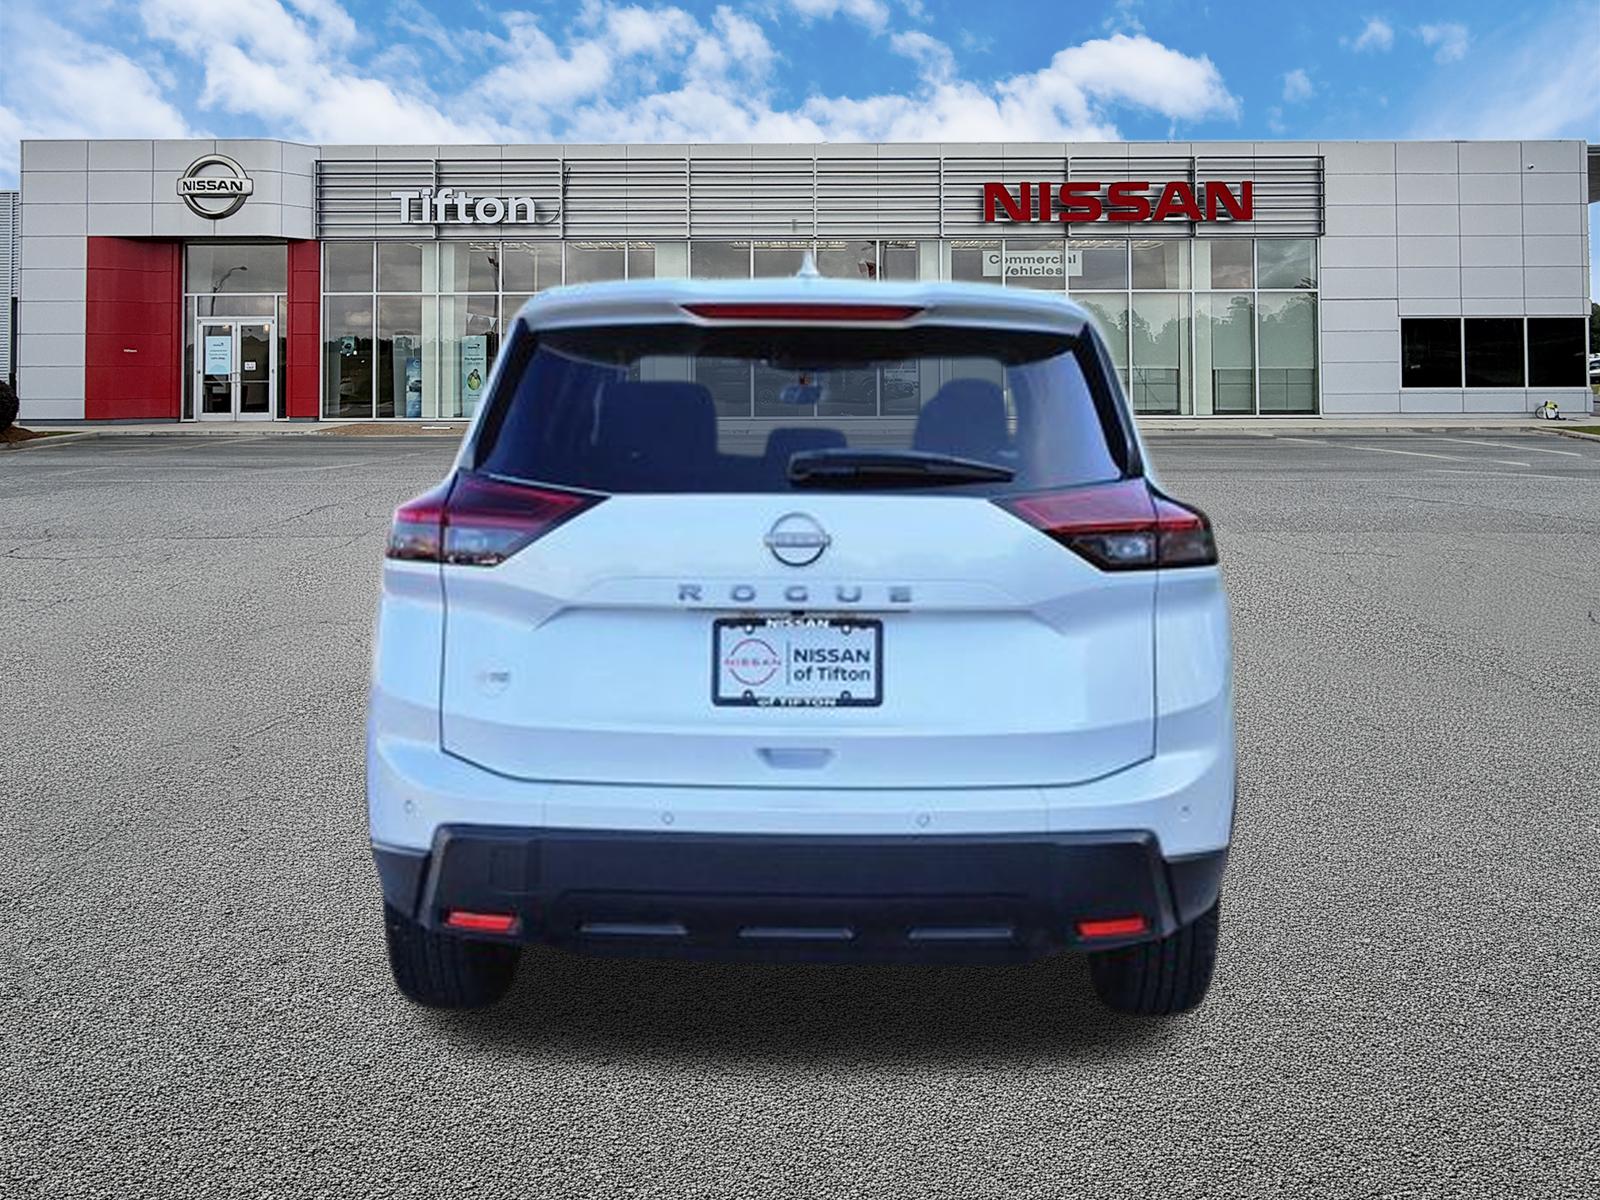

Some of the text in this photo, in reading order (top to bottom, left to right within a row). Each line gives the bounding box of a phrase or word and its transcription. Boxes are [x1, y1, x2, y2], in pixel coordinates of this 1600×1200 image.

[182, 180, 243, 191] NISSAN
[391, 188, 536, 224] Tifton
[983, 180, 1253, 222] NISSAN
[678, 585, 911, 603] ROGUE
[766, 619, 829, 628] NISSAN
[794, 649, 870, 663] NISSAN
[794, 667, 870, 681] of Tifton
